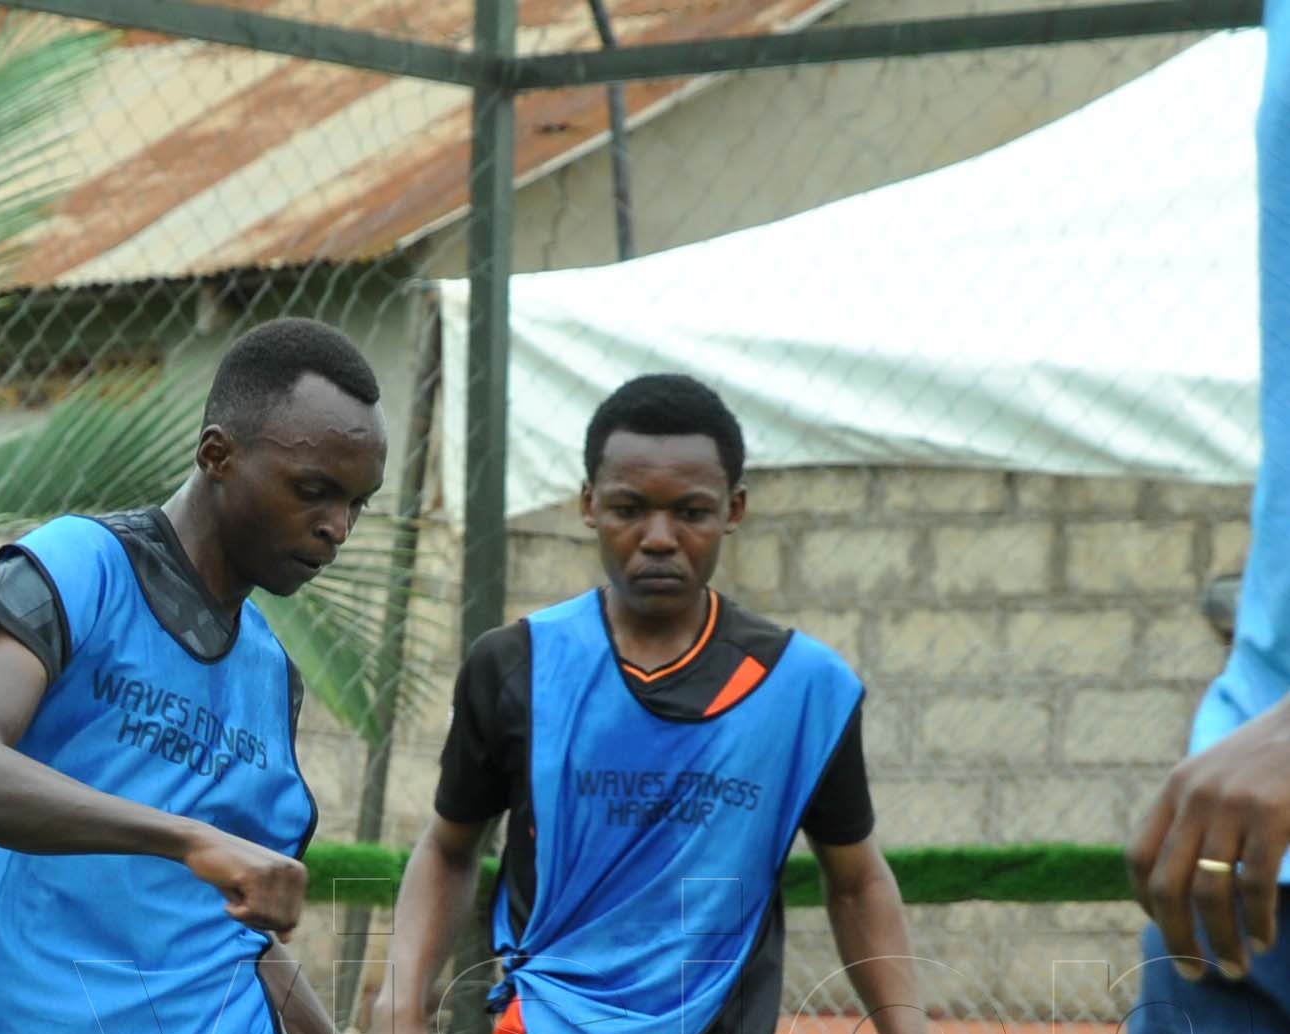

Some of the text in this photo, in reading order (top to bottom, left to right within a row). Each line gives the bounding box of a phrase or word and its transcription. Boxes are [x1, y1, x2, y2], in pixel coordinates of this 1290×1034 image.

[92, 668, 267, 770] WAVES FITNESS
[117, 713, 232, 784] HARBOUR
[575, 769, 666, 799] WAVES
